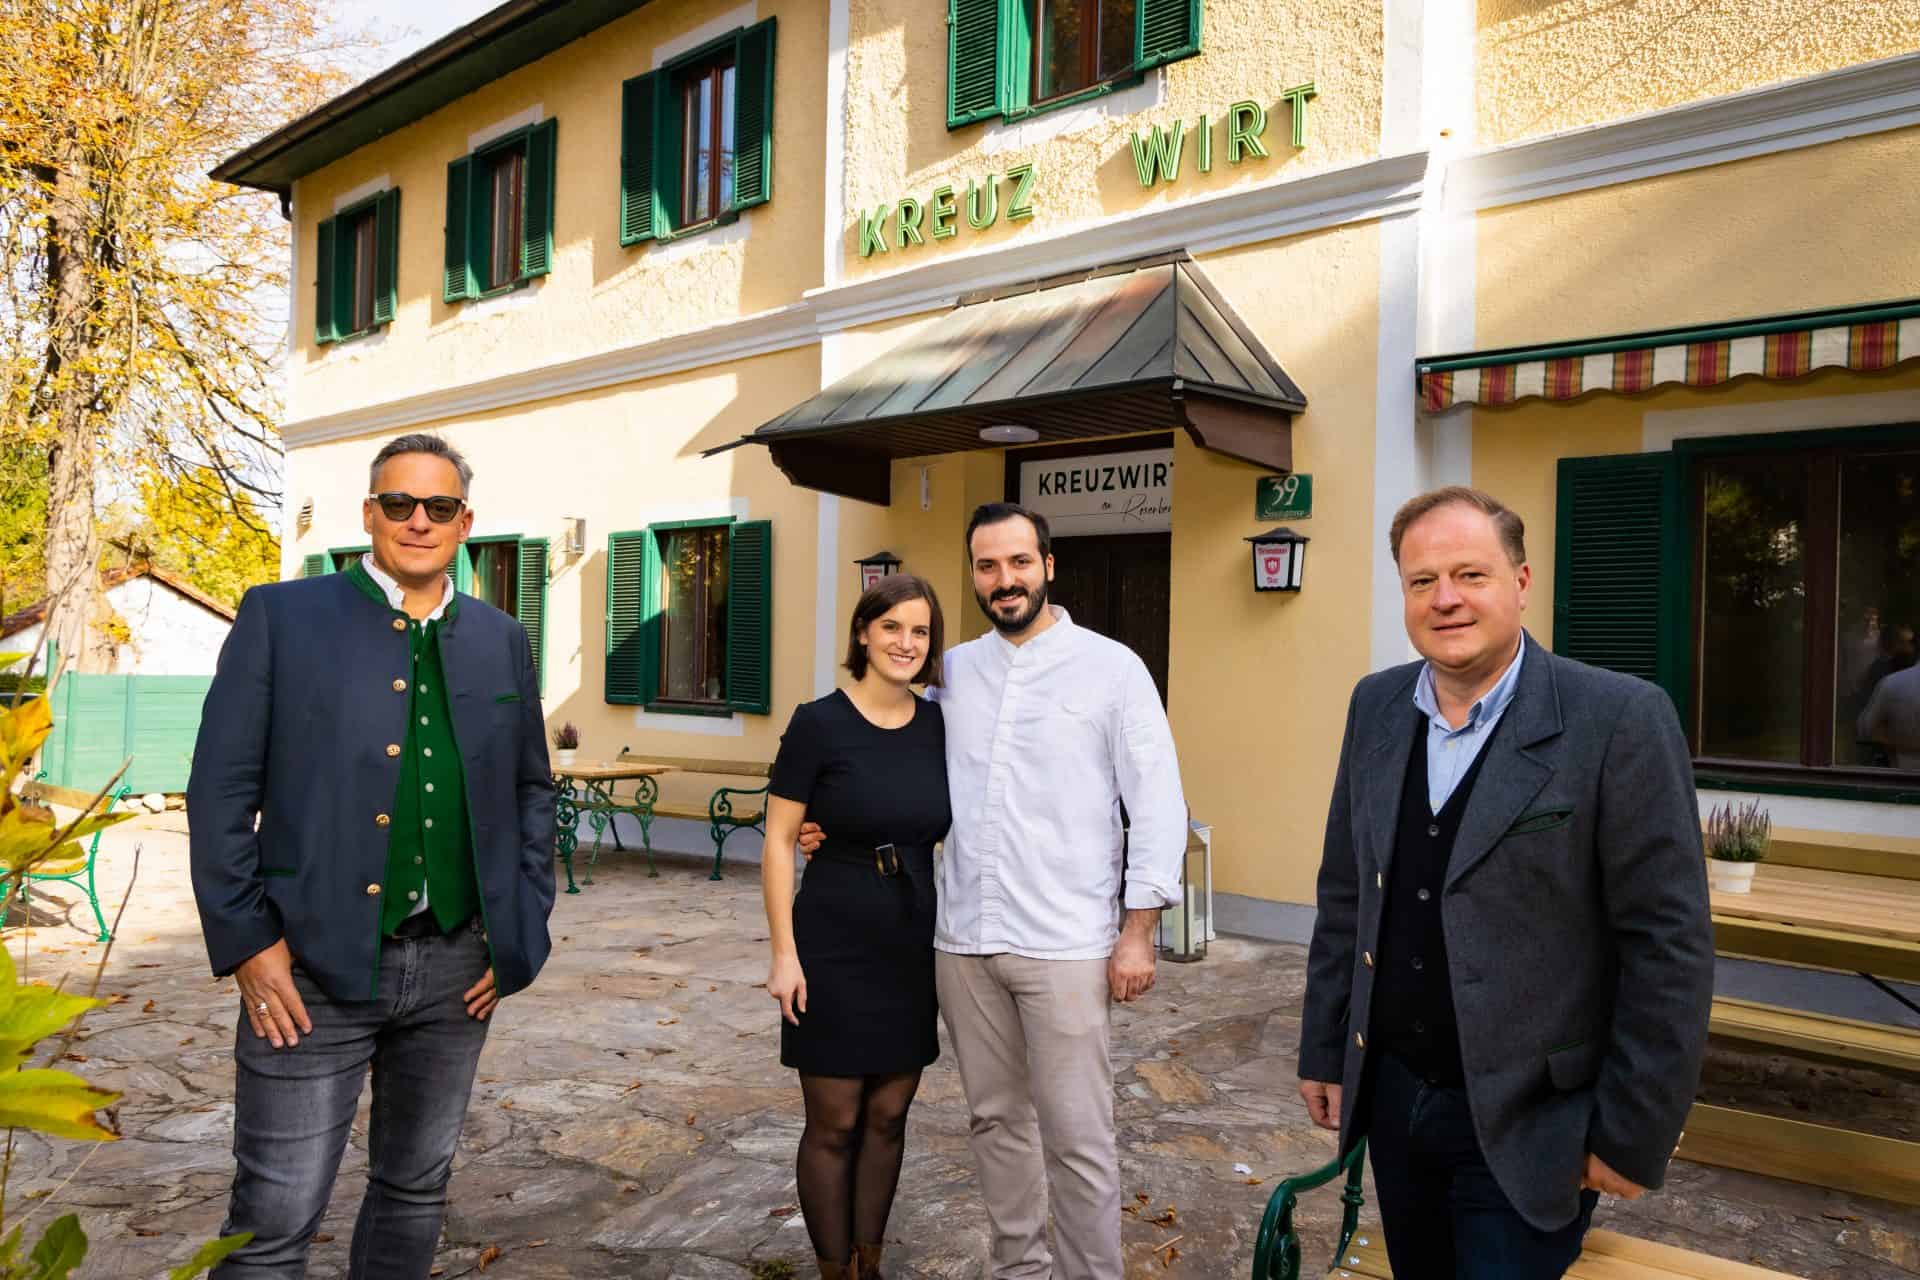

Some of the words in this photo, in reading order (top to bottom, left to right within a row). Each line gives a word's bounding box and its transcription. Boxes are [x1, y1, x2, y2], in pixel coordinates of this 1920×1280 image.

[859, 163, 1035, 257] KREUZ
[1131, 83, 1318, 187] WIRT
[1039, 461, 1173, 496] KREUZWIR
[1269, 475, 1300, 506] 39
